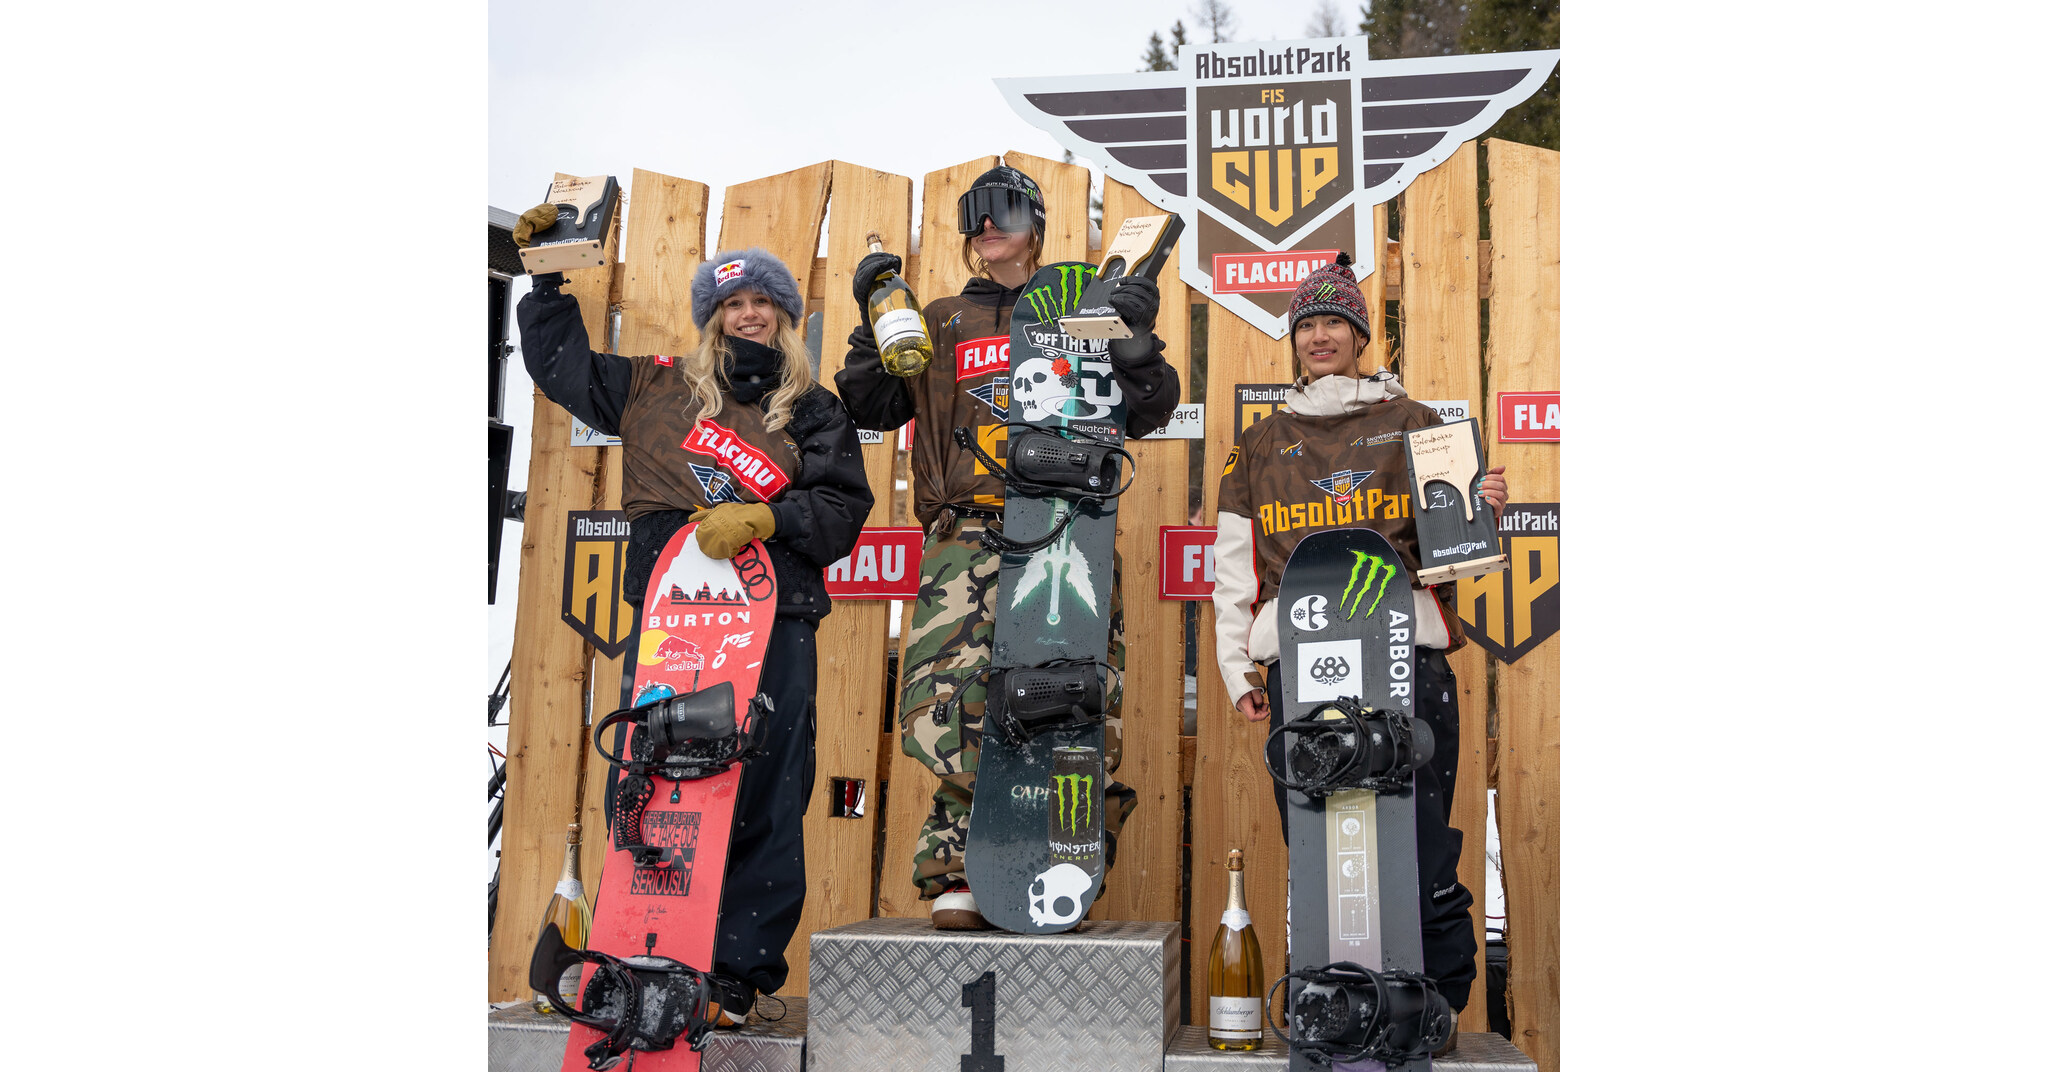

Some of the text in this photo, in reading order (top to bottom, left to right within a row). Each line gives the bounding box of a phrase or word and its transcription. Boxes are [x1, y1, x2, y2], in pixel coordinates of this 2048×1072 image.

[1196, 44, 1350, 79] AbsolutPark
[1261, 89, 1284, 103] FIS
[1211, 98, 1338, 148] world
[1212, 147, 1338, 227] CUP
[1072, 424, 1110, 434] swatch
[1366, 431, 1403, 442] SNOWBOARD
[697, 427, 776, 487] FLACHAU
[1260, 488, 1416, 536] AbsolutPar
[1432, 546, 1460, 558] Absolut
[1471, 540, 1487, 551] Park
[648, 611, 750, 628] BURTON
[684, 660, 705, 671] Bull
[1310, 656, 1350, 680] 686
[645, 811, 701, 825] HERE AT BURTON
[659, 824, 680, 847] TAKE
[681, 825, 700, 848] OUR
[1053, 853, 1095, 861] ENERGY
[632, 869, 692, 895] SERIOUSLY
[961, 971, 1005, 1072] 1
